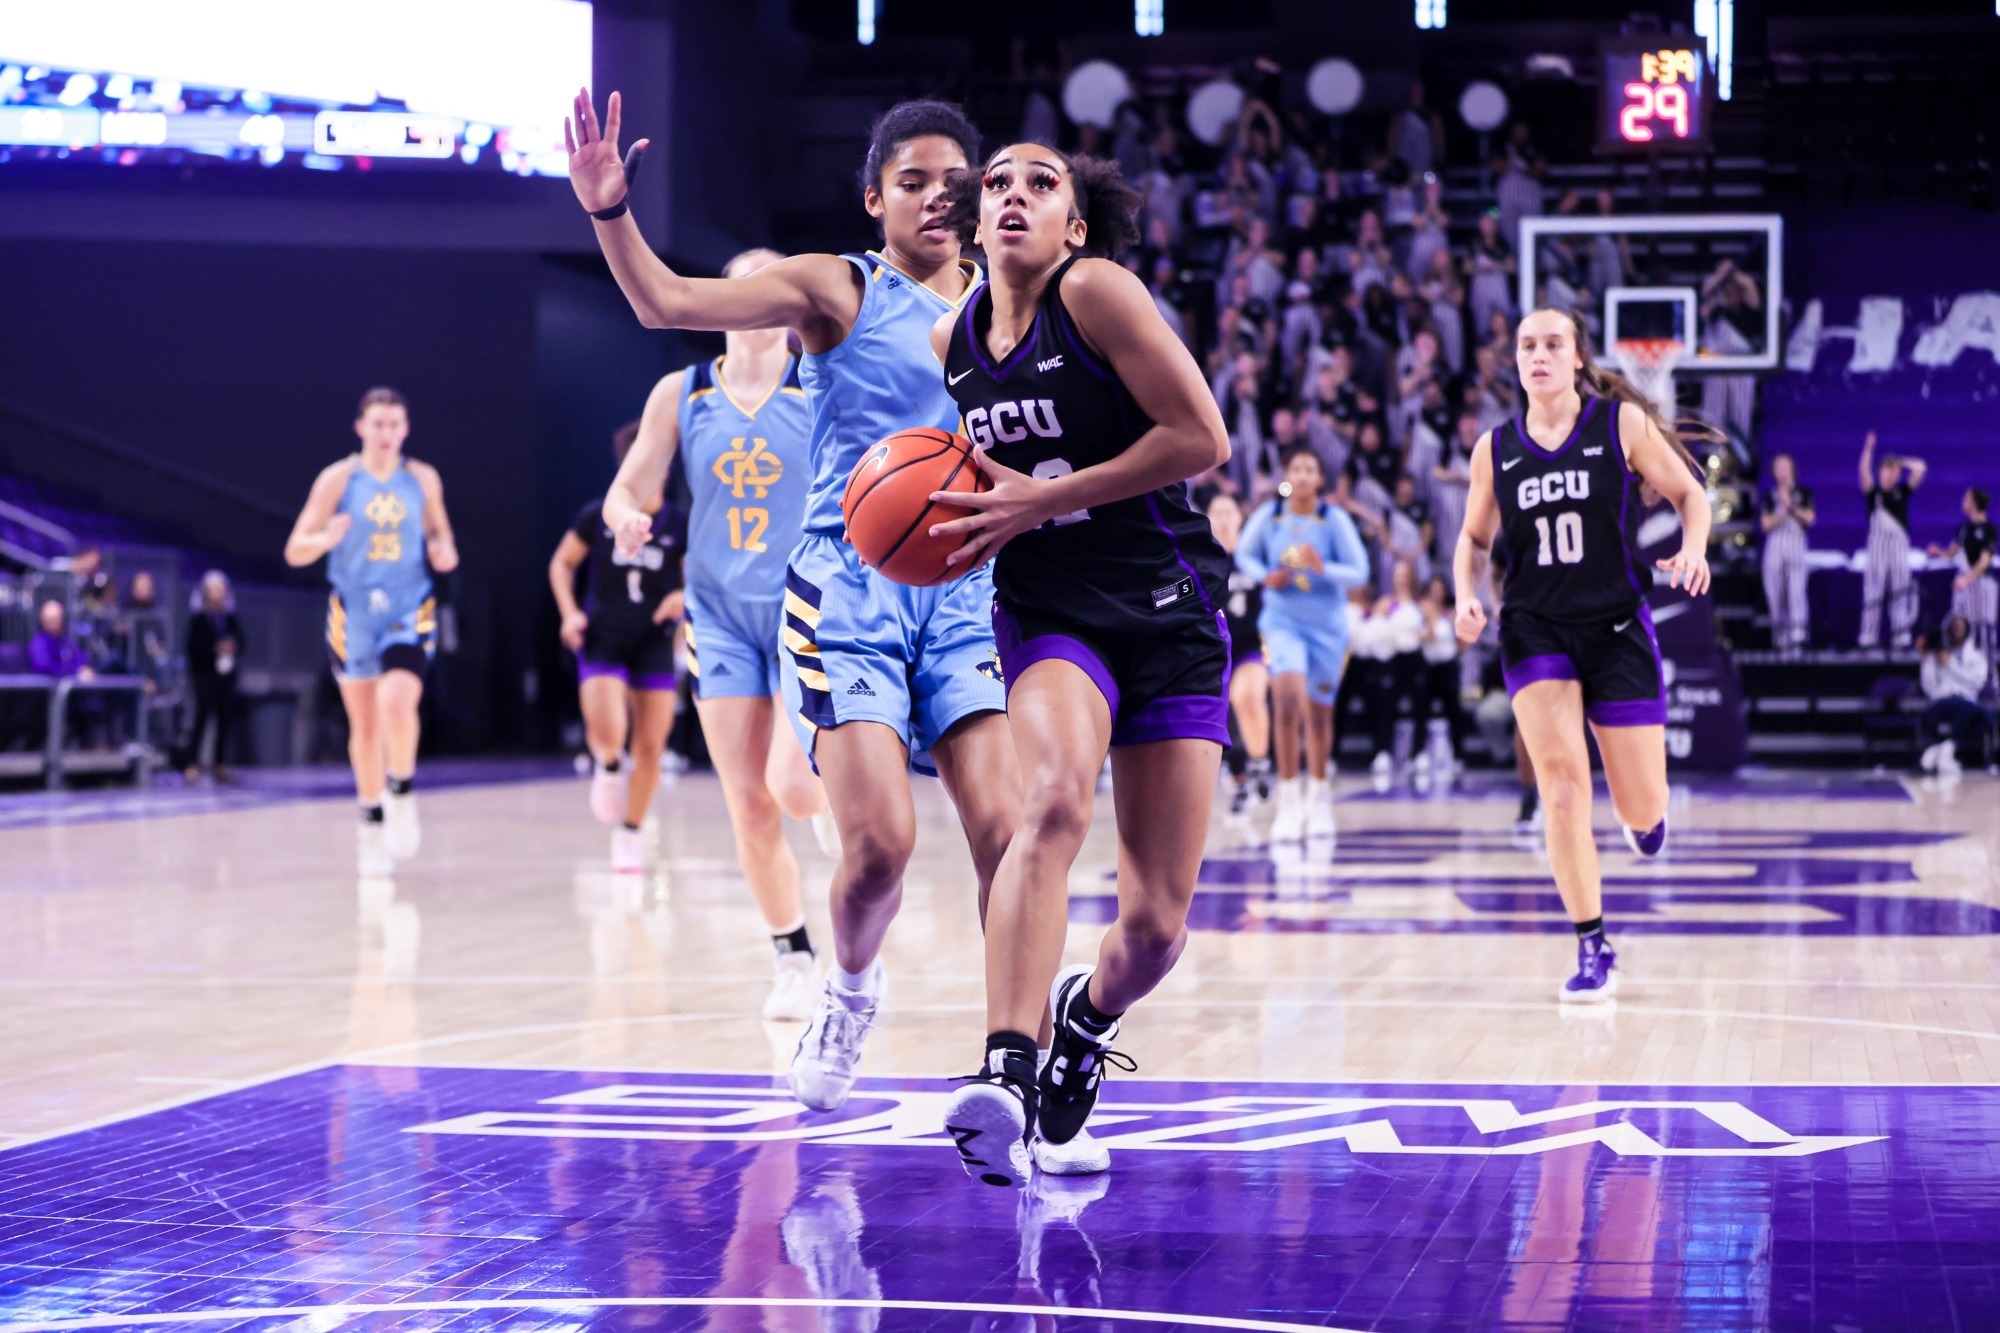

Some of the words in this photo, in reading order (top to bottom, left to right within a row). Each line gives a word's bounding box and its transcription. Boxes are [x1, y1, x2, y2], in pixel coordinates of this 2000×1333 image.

[1620, 83, 1687, 141] 29
[1037, 355, 1064, 372] WAC
[966, 399, 1063, 451] GCU
[1517, 471, 1590, 510] GCU
[727, 507, 769, 553] 12
[1535, 512, 1584, 566] 10
[1182, 584, 1189, 593] S
